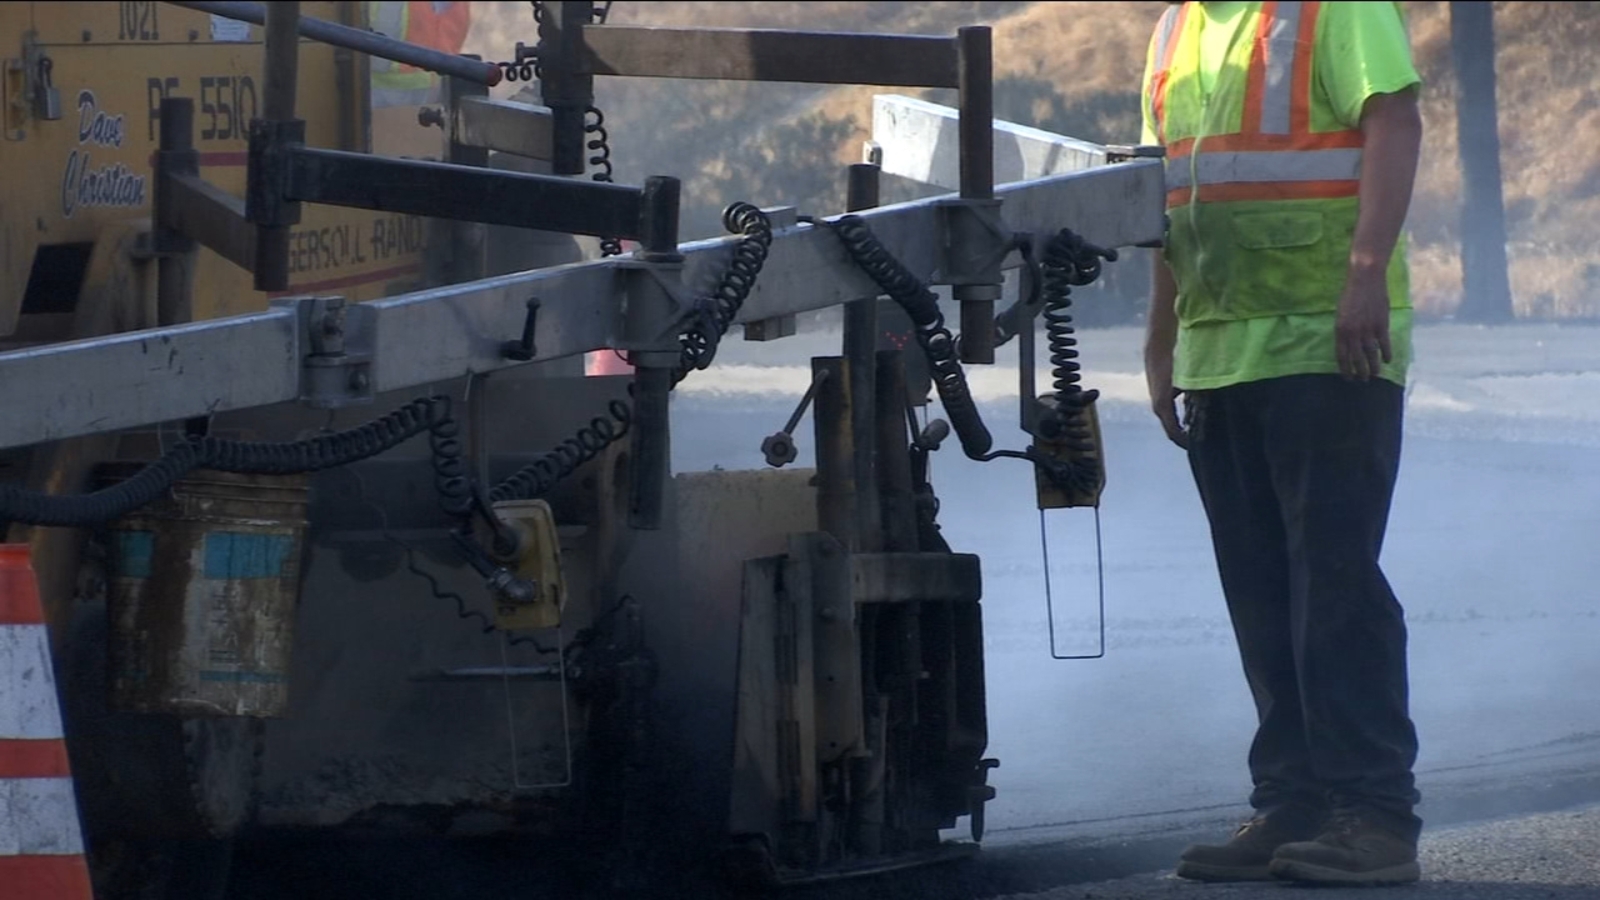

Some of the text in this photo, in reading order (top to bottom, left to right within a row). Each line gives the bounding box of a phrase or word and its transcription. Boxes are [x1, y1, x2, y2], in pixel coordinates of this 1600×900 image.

[118, 1, 159, 40] 1021
[78, 89, 125, 150] Dave
[200, 75, 257, 141] 5510
[61, 149, 146, 219] Christian
